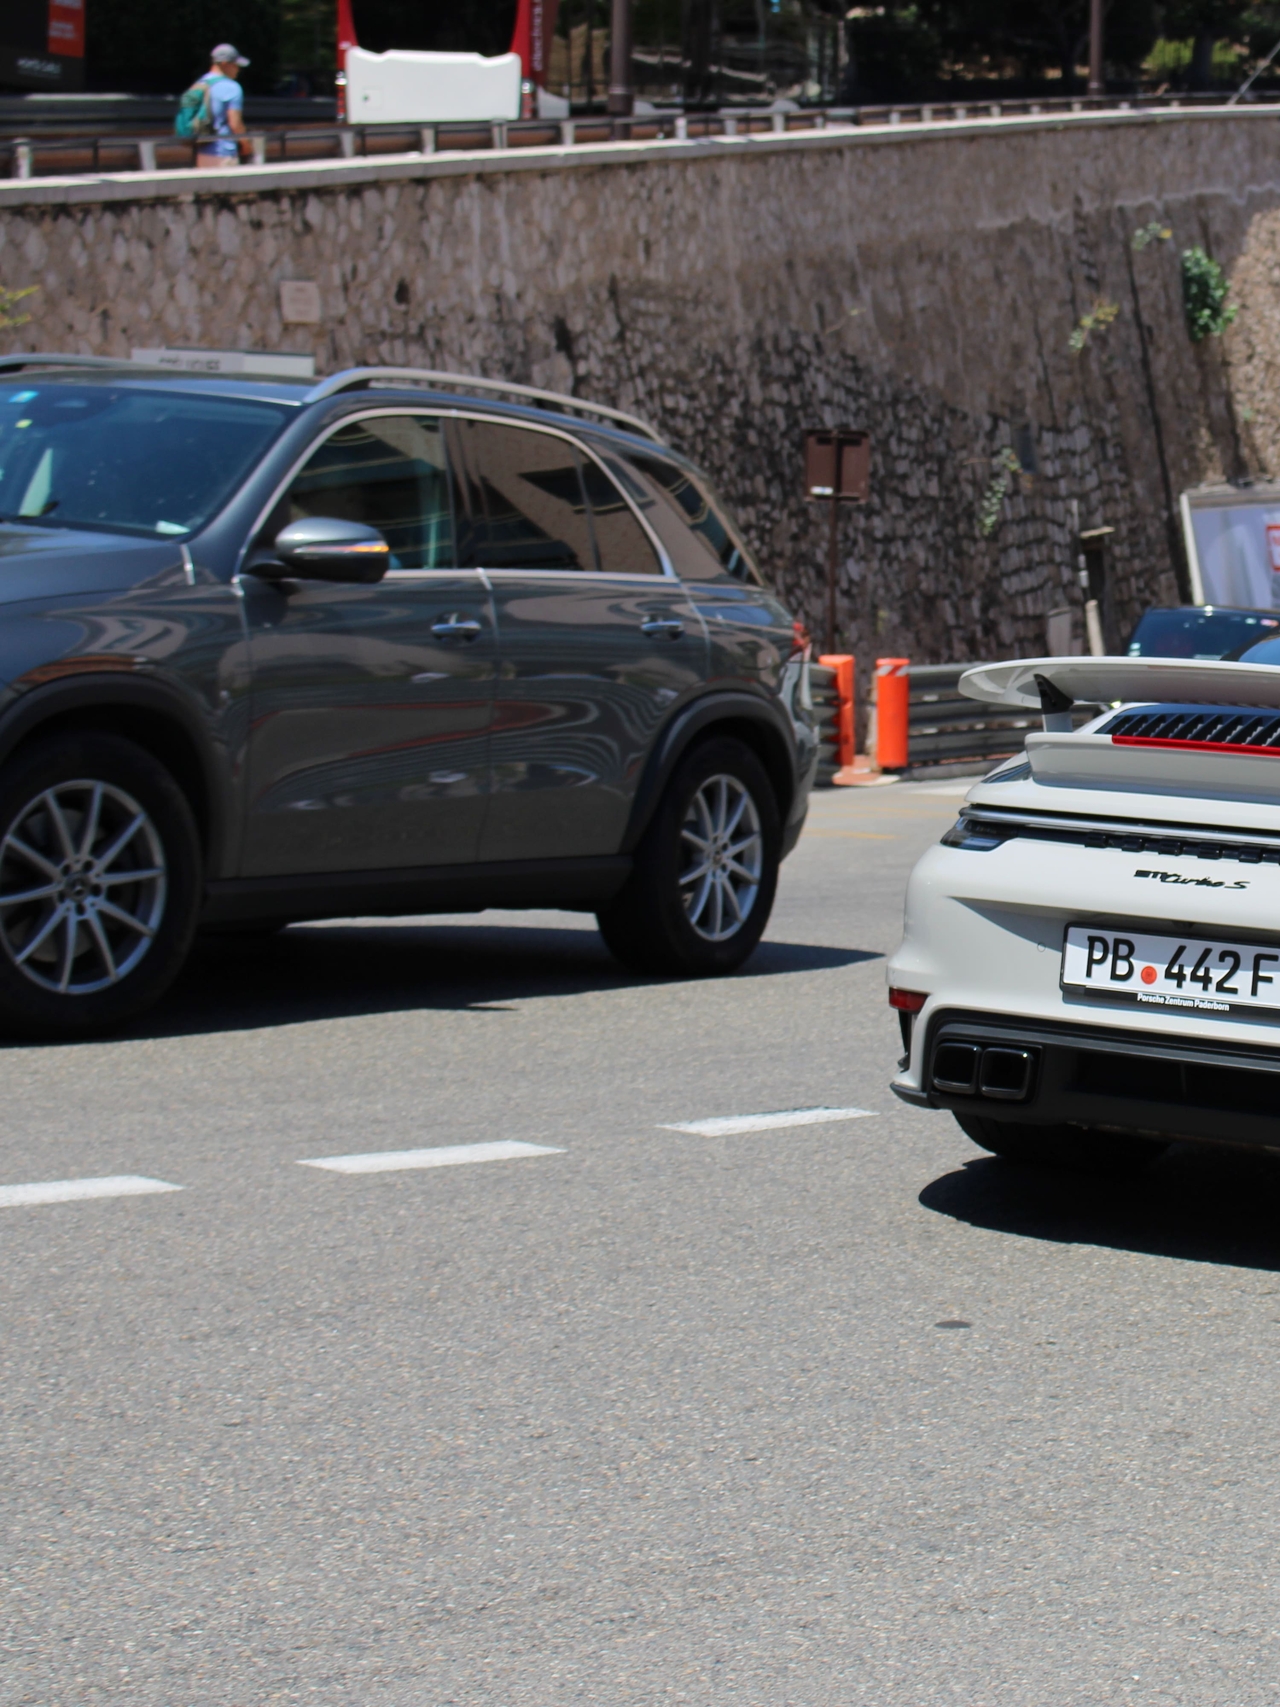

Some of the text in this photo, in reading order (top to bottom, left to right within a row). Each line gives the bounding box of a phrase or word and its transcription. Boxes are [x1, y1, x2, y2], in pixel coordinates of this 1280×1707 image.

[1223, 881, 1251, 889] S
[1086, 935, 1279, 996] PB 442 F
[1137, 993, 1230, 1011] Porsche Zentrum Paderborn
